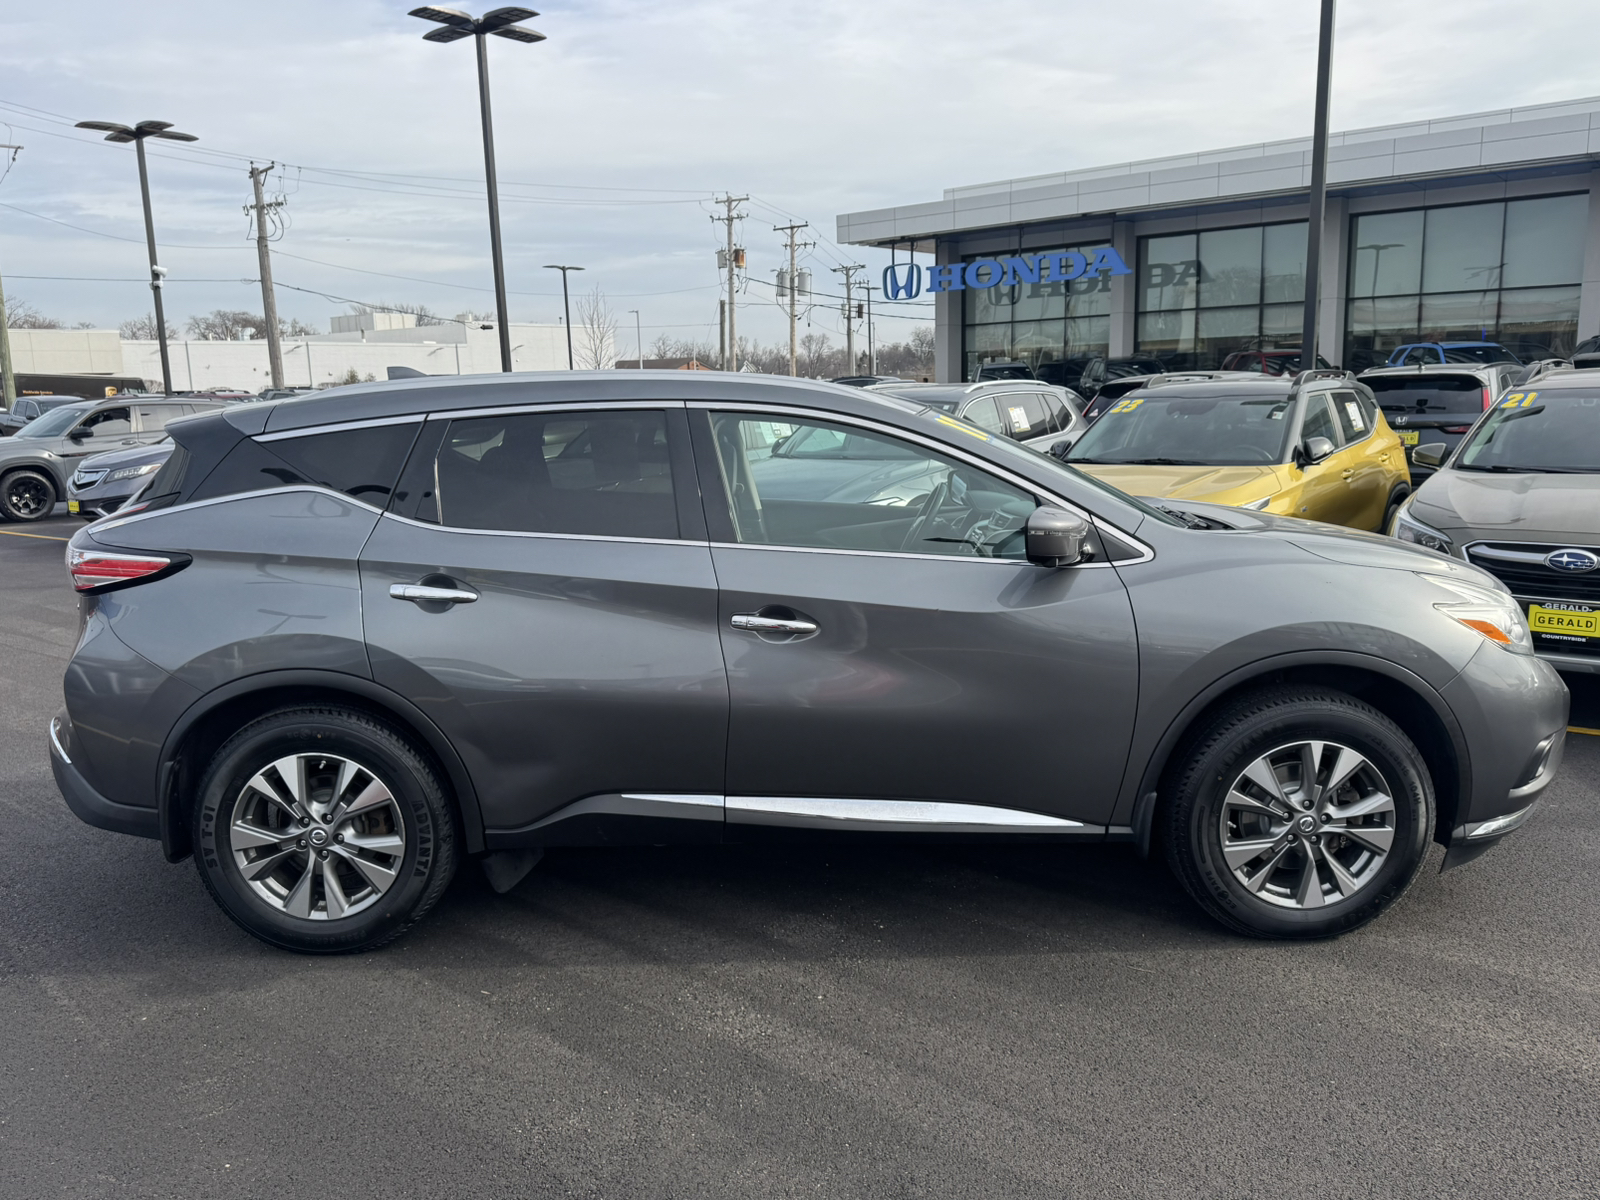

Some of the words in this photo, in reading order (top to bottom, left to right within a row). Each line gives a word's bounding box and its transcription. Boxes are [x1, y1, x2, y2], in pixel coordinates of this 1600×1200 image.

[926, 246, 1132, 293] HONDA
[1109, 398, 1146, 414] 23
[1500, 391, 1537, 408] 21
[1544, 602, 1589, 613] GERALD
[1537, 616, 1594, 629] GERALD
[1541, 633, 1587, 643] COUNTRYSIDE
[411, 800, 431, 878] ADVANTA
